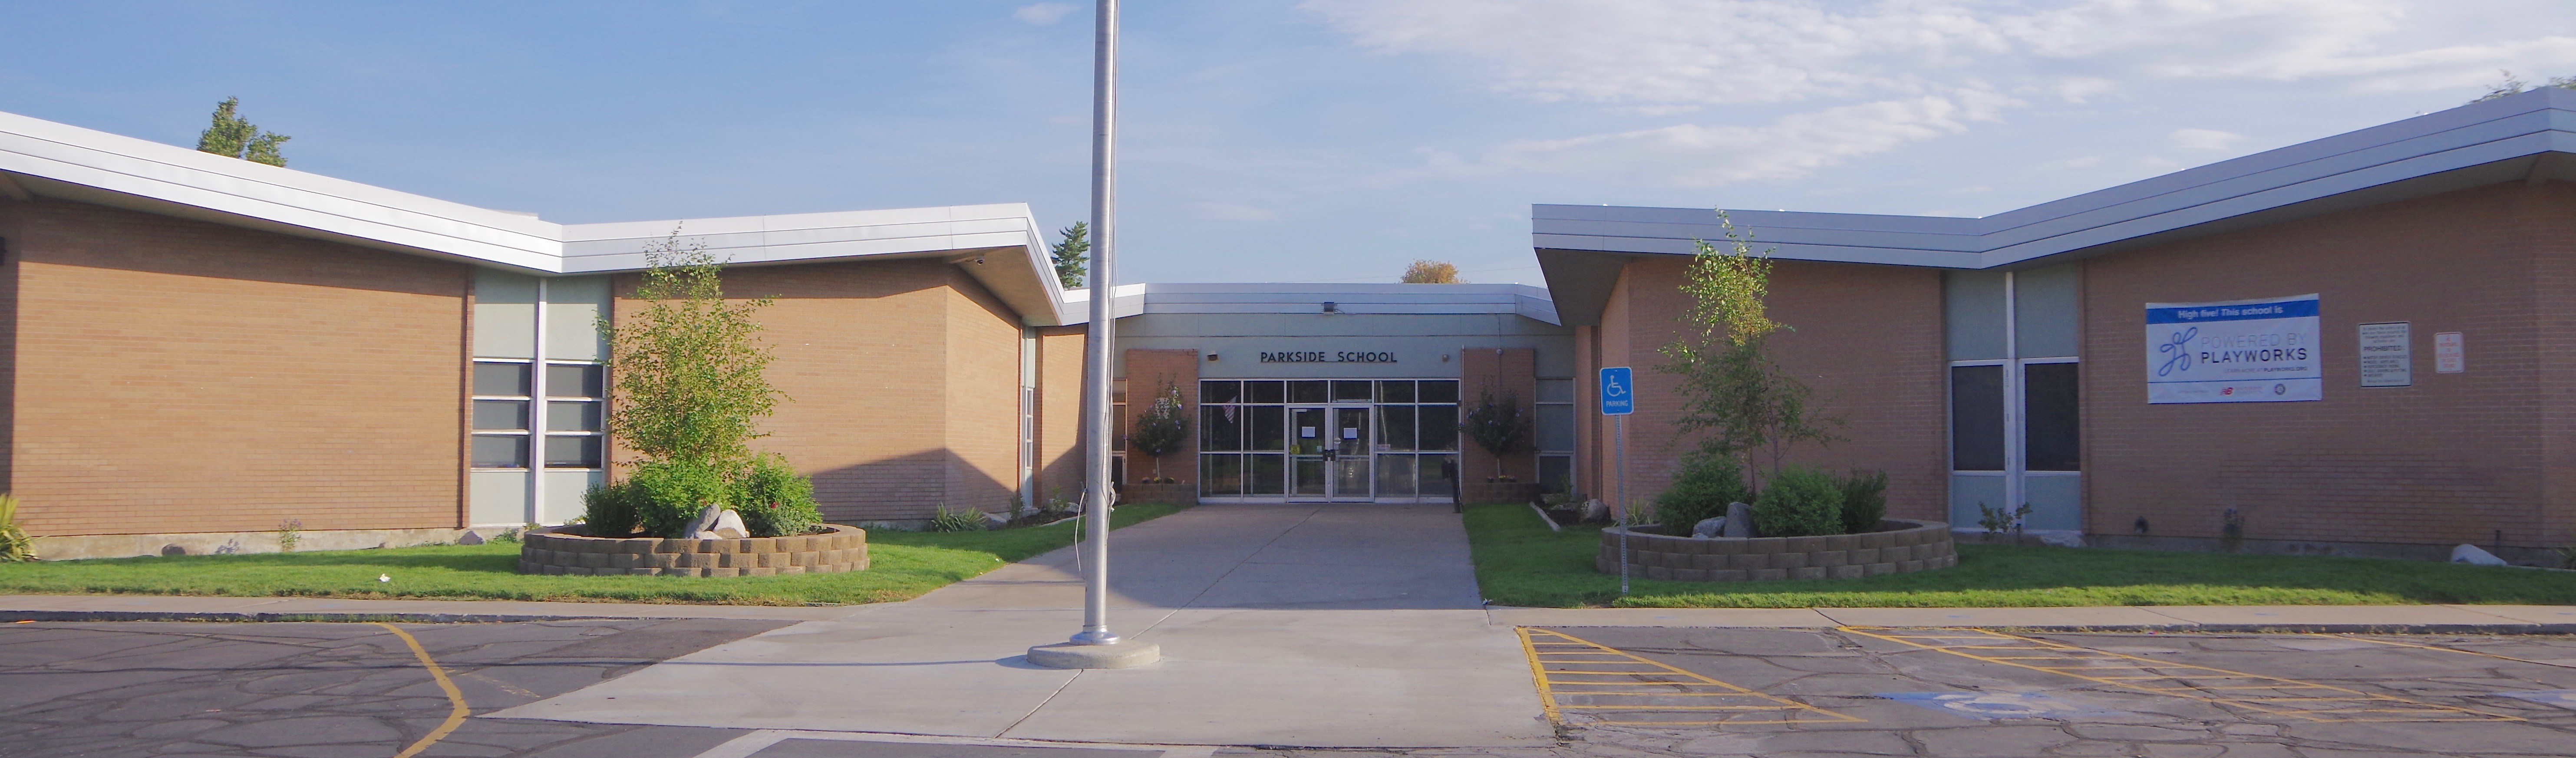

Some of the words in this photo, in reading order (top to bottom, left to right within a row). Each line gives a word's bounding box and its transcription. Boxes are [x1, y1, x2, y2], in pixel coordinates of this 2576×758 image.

[2178, 310, 2198, 320] High
[2200, 309, 2219, 318] five!
[2221, 308, 2240, 317] This
[2242, 307, 2273, 316] school
[2274, 306, 2283, 314] is
[2201, 334, 2281, 349] POWERED
[2288, 333, 2307, 346] BY
[1260, 352, 1325, 363] PARKSIDE
[1337, 352, 1398, 363] SCHOOL
[2201, 348, 2307, 363] PLAYWORKS
